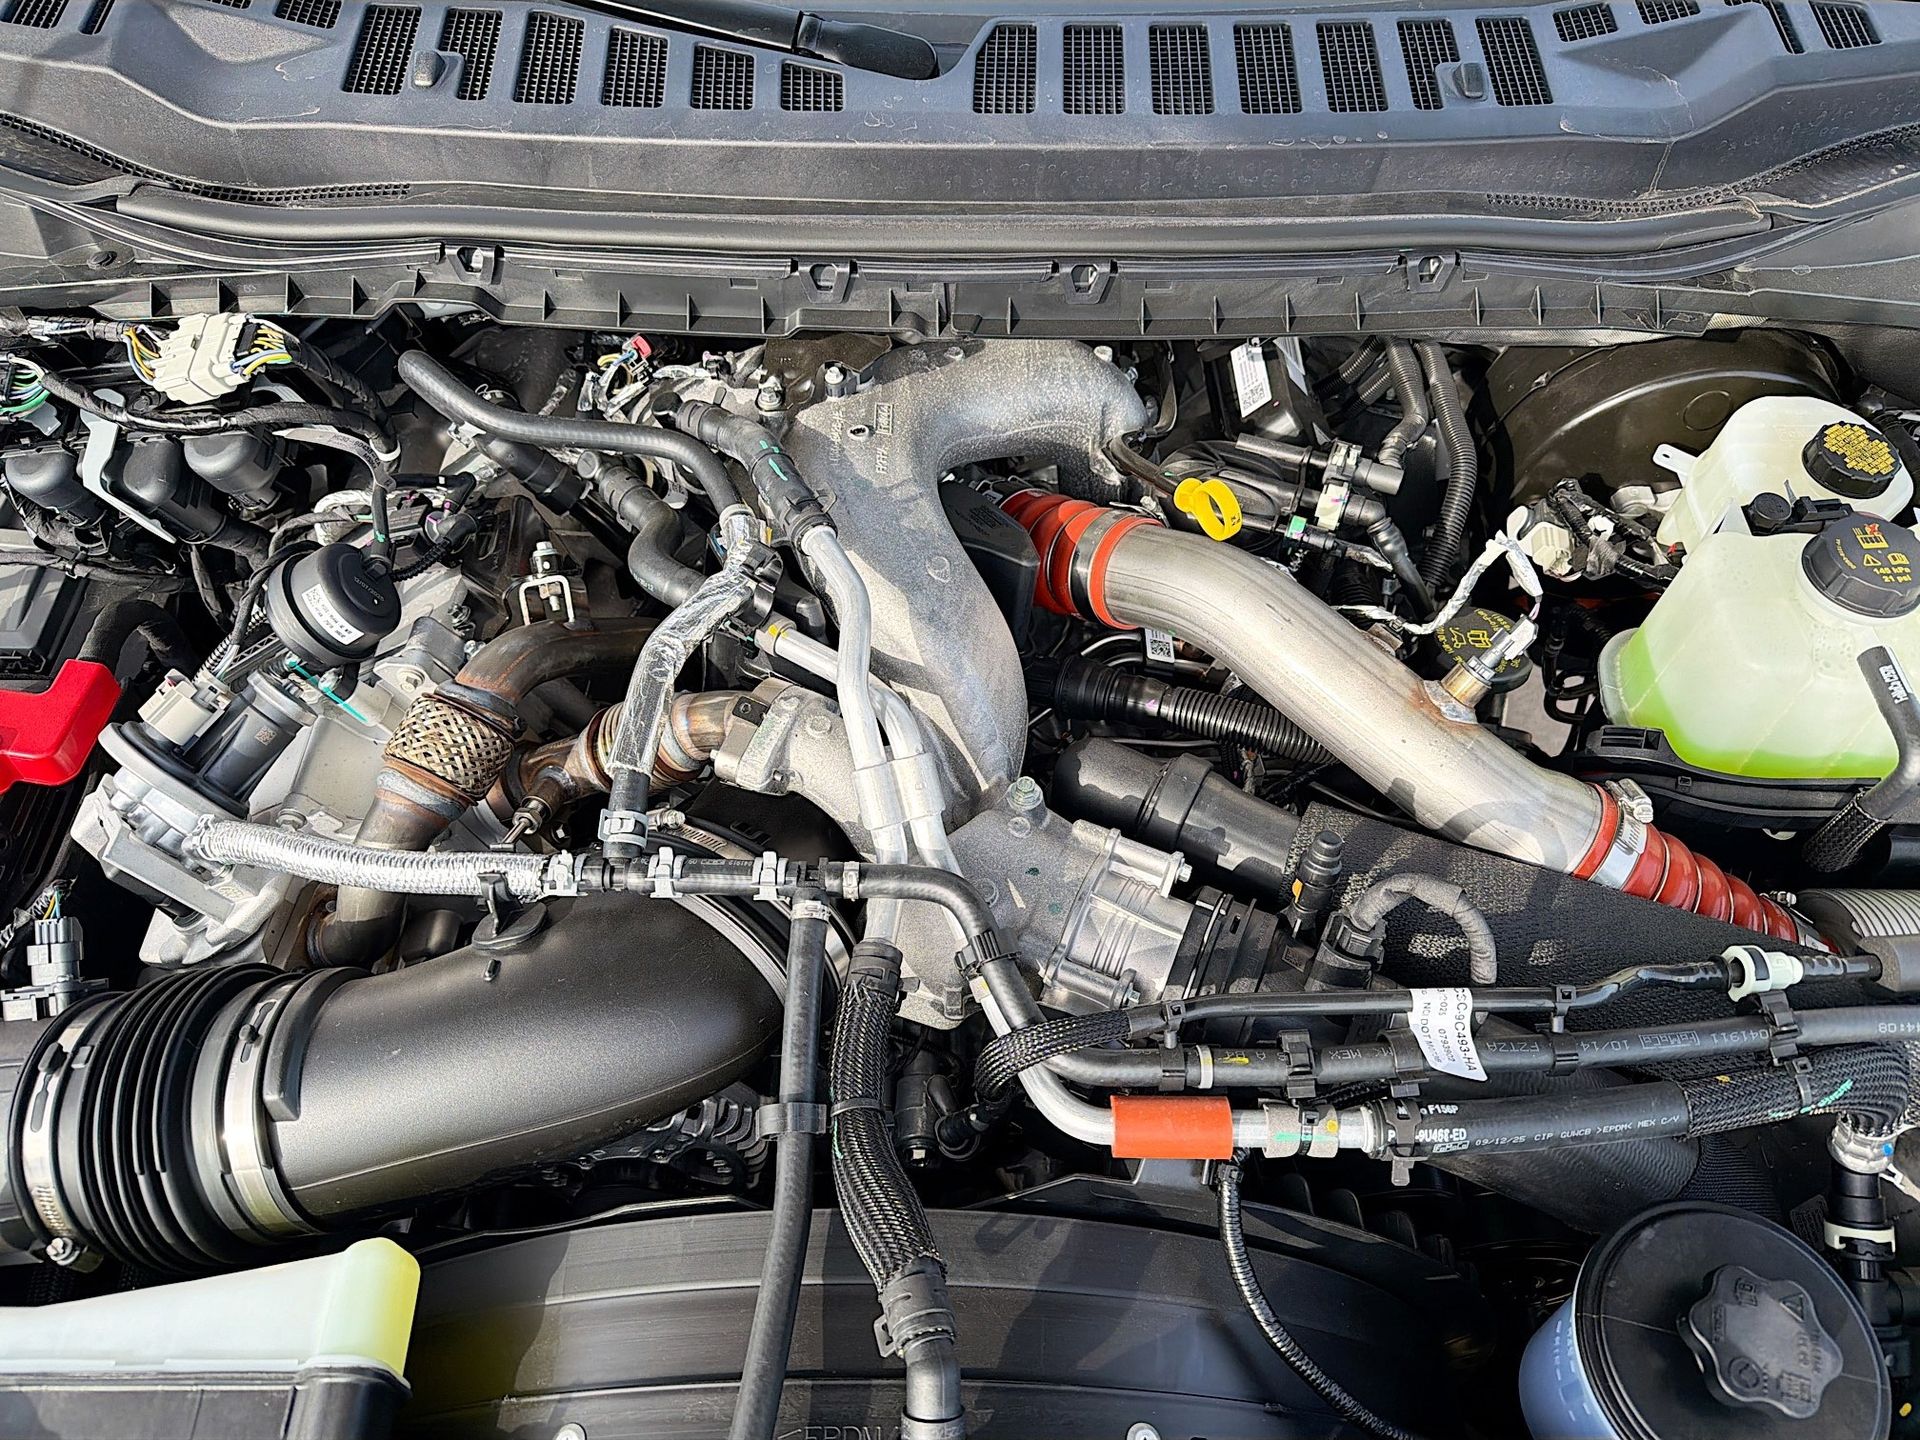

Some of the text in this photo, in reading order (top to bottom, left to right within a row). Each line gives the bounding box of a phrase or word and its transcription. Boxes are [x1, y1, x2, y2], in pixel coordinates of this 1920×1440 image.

[1893, 566, 1911, 574] kPa
[1579, 1037, 1629, 1055] 10/14
[1710, 1029, 1769, 1046] 041911
[1329, 1048, 1362, 1063] MEX
[1475, 1135, 1526, 1147] 09/12/25
[1534, 1132, 1554, 1142] CIP
[1637, 1118, 1657, 1128] MEX
